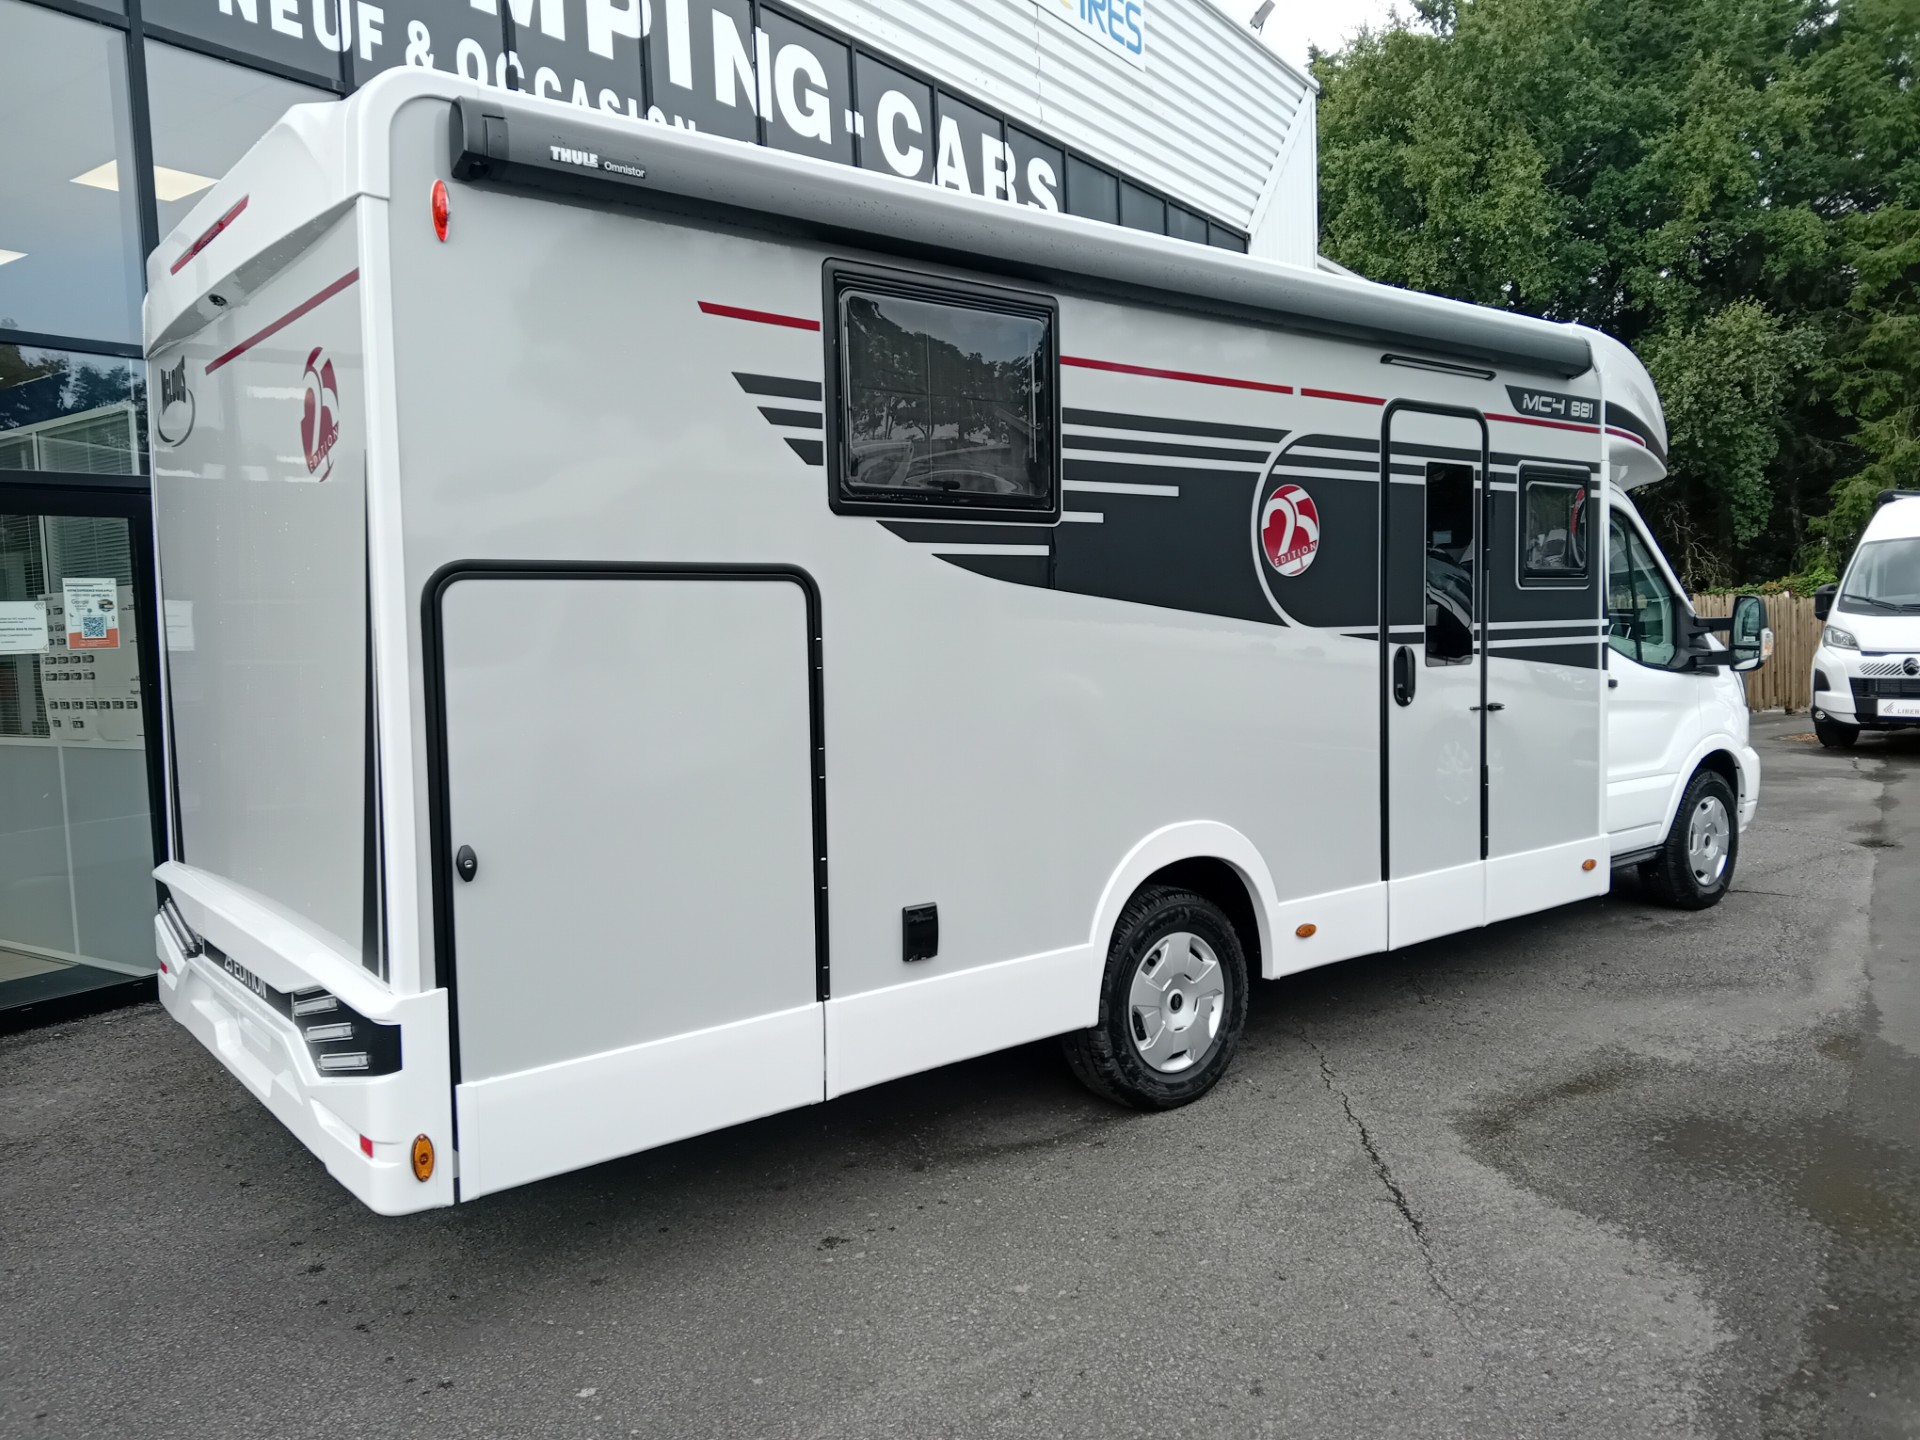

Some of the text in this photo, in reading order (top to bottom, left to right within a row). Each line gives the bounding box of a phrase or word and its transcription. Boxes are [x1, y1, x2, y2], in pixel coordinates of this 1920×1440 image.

[405, 19, 435, 69] &
[469, 0, 1059, 213] PING-CARS
[550, 145, 645, 178] THULE Omnistor
[1570, 401, 1594, 419] 881
[309, 422, 338, 472] EDITION
[1274, 541, 1317, 567] EDITION
